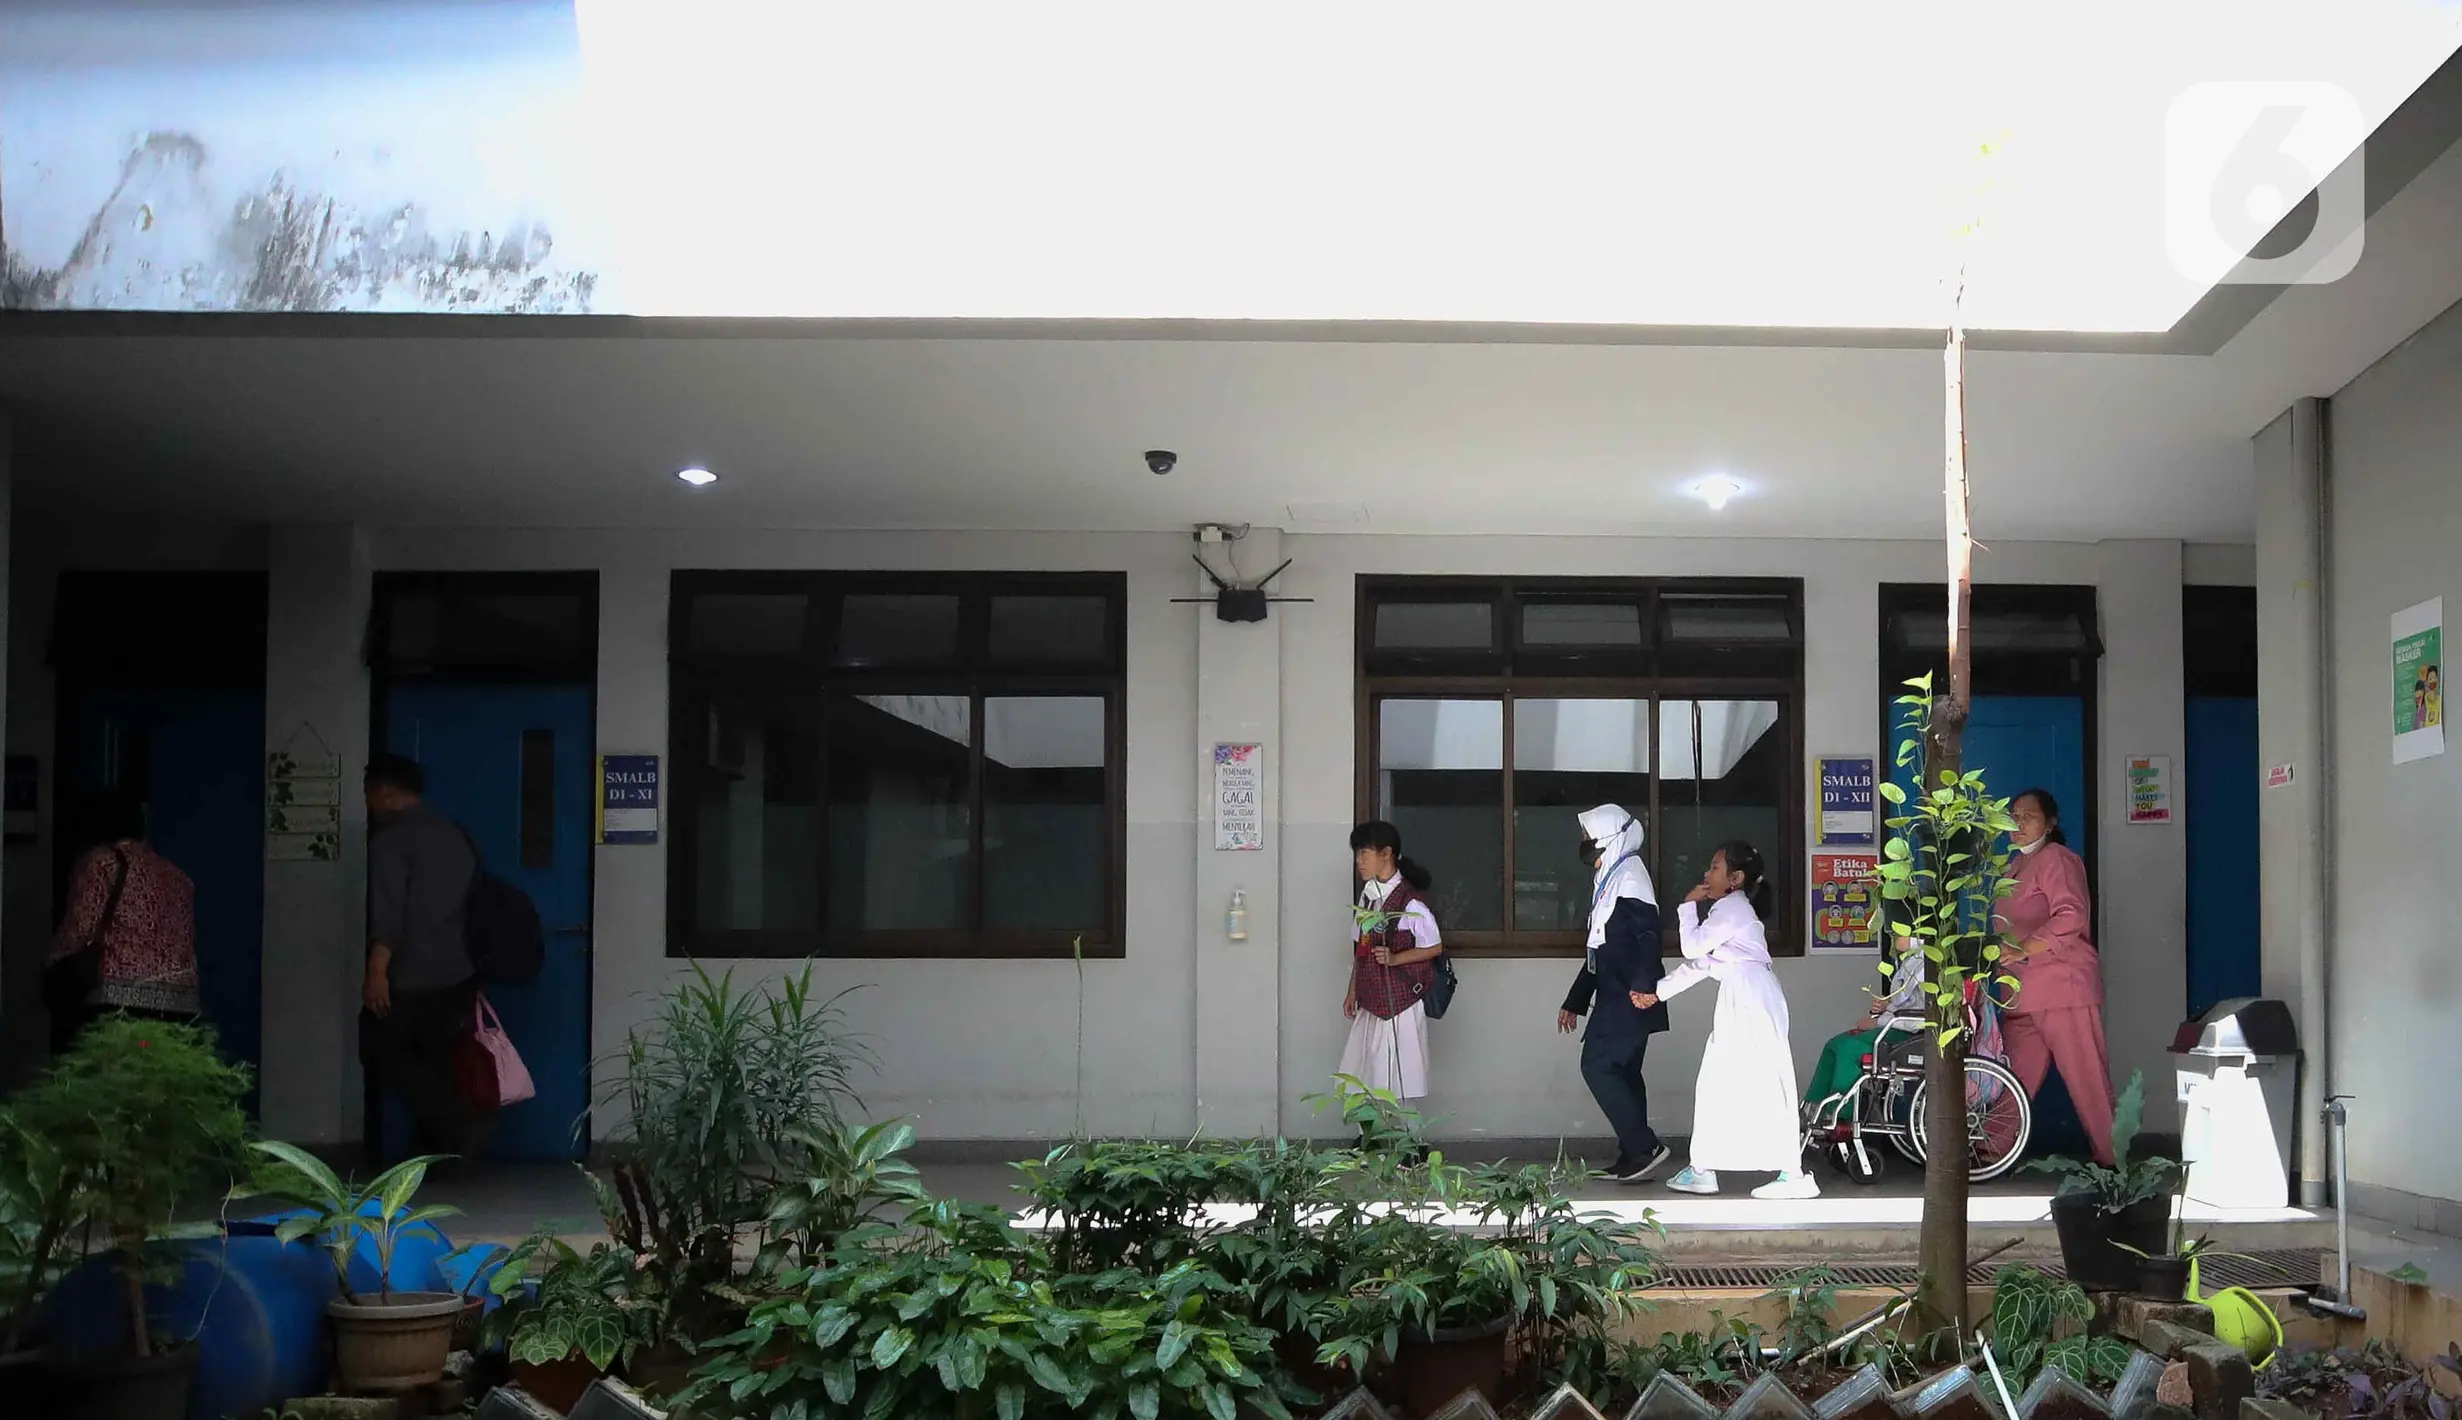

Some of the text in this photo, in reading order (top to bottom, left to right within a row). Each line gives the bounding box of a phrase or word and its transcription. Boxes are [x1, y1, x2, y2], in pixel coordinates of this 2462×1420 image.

[606, 772, 656, 784] SMALB
[1823, 775, 1871, 787] SMALB
[637, 788, 652, 800] XI
[1222, 791, 1254, 804] GAGAL
[1851, 791, 1870, 803] XII
[1833, 859, 1867, 869] Etika
